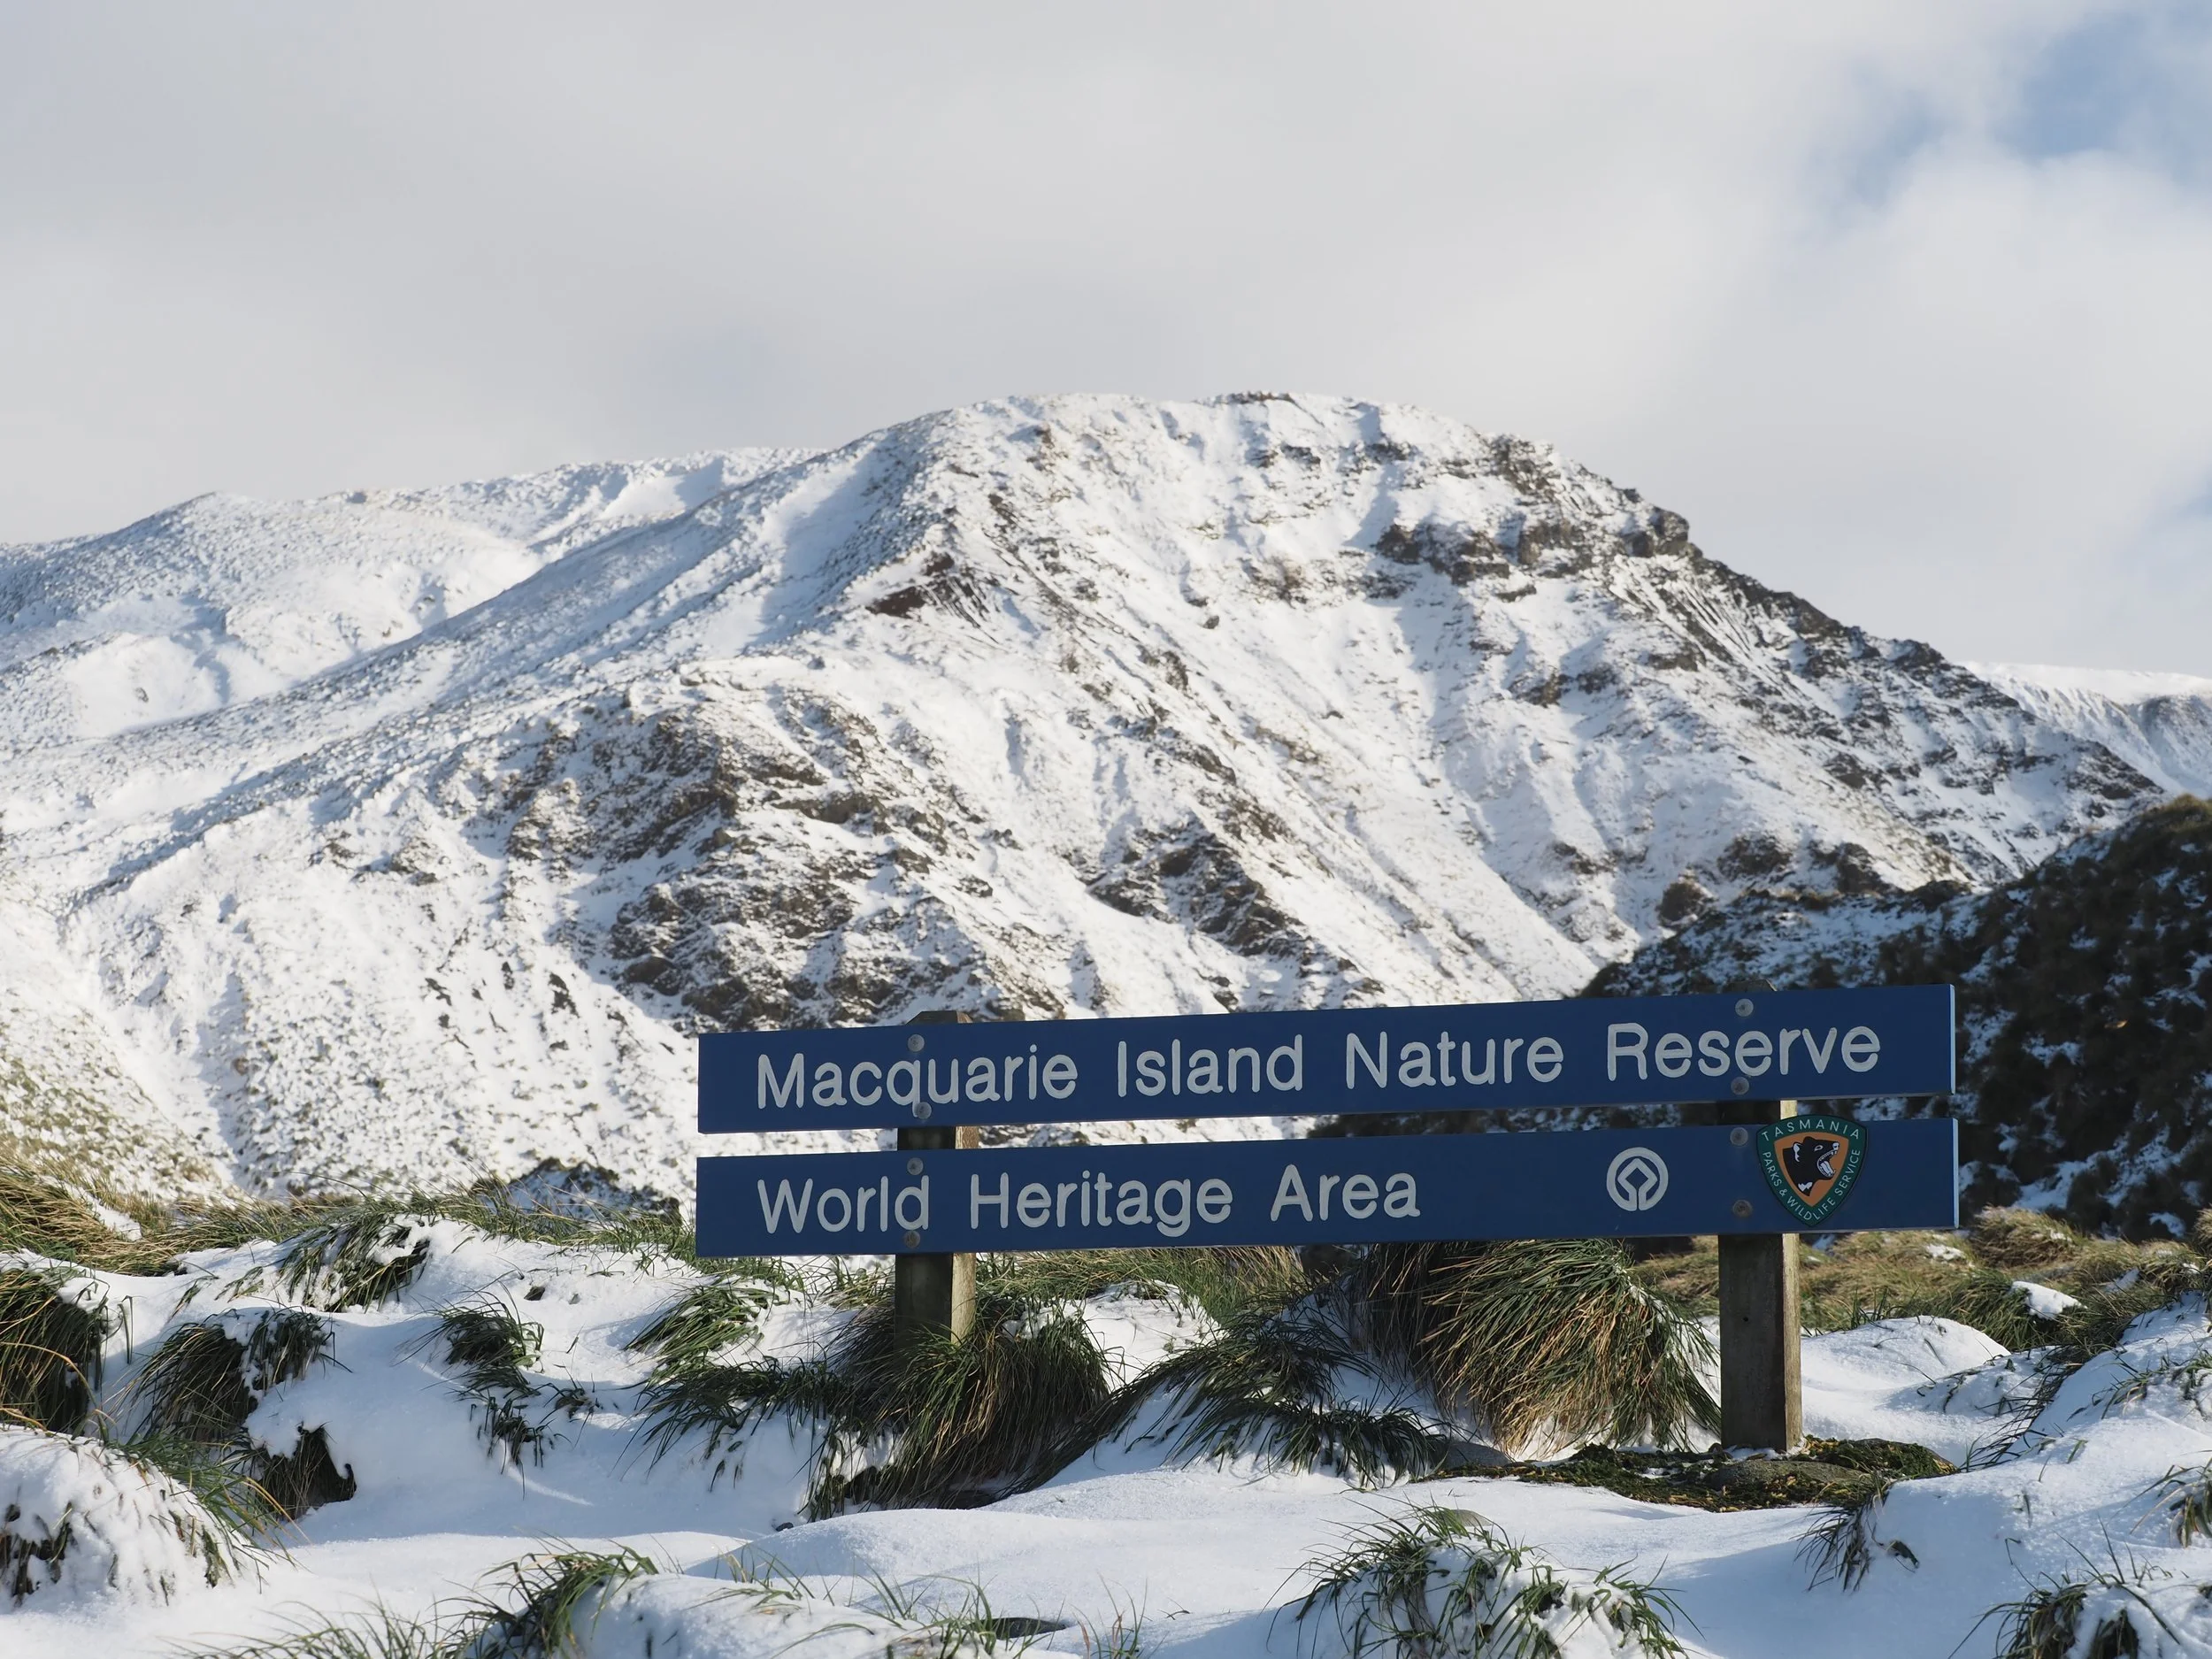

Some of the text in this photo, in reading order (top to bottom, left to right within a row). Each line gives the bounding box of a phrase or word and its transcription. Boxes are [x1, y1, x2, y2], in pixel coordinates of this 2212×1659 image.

[757, 1022, 1881, 1118] Macquarie Island Nature Reserve
[1761, 1118, 1860, 1141] TASMANIA
[757, 1164, 1421, 1238] World Heritage Area
[1762, 1151, 1782, 1187] PARKS
[1786, 1195, 1836, 1221] WILDLIFE
[1834, 1148, 1861, 1196] SERVICE
